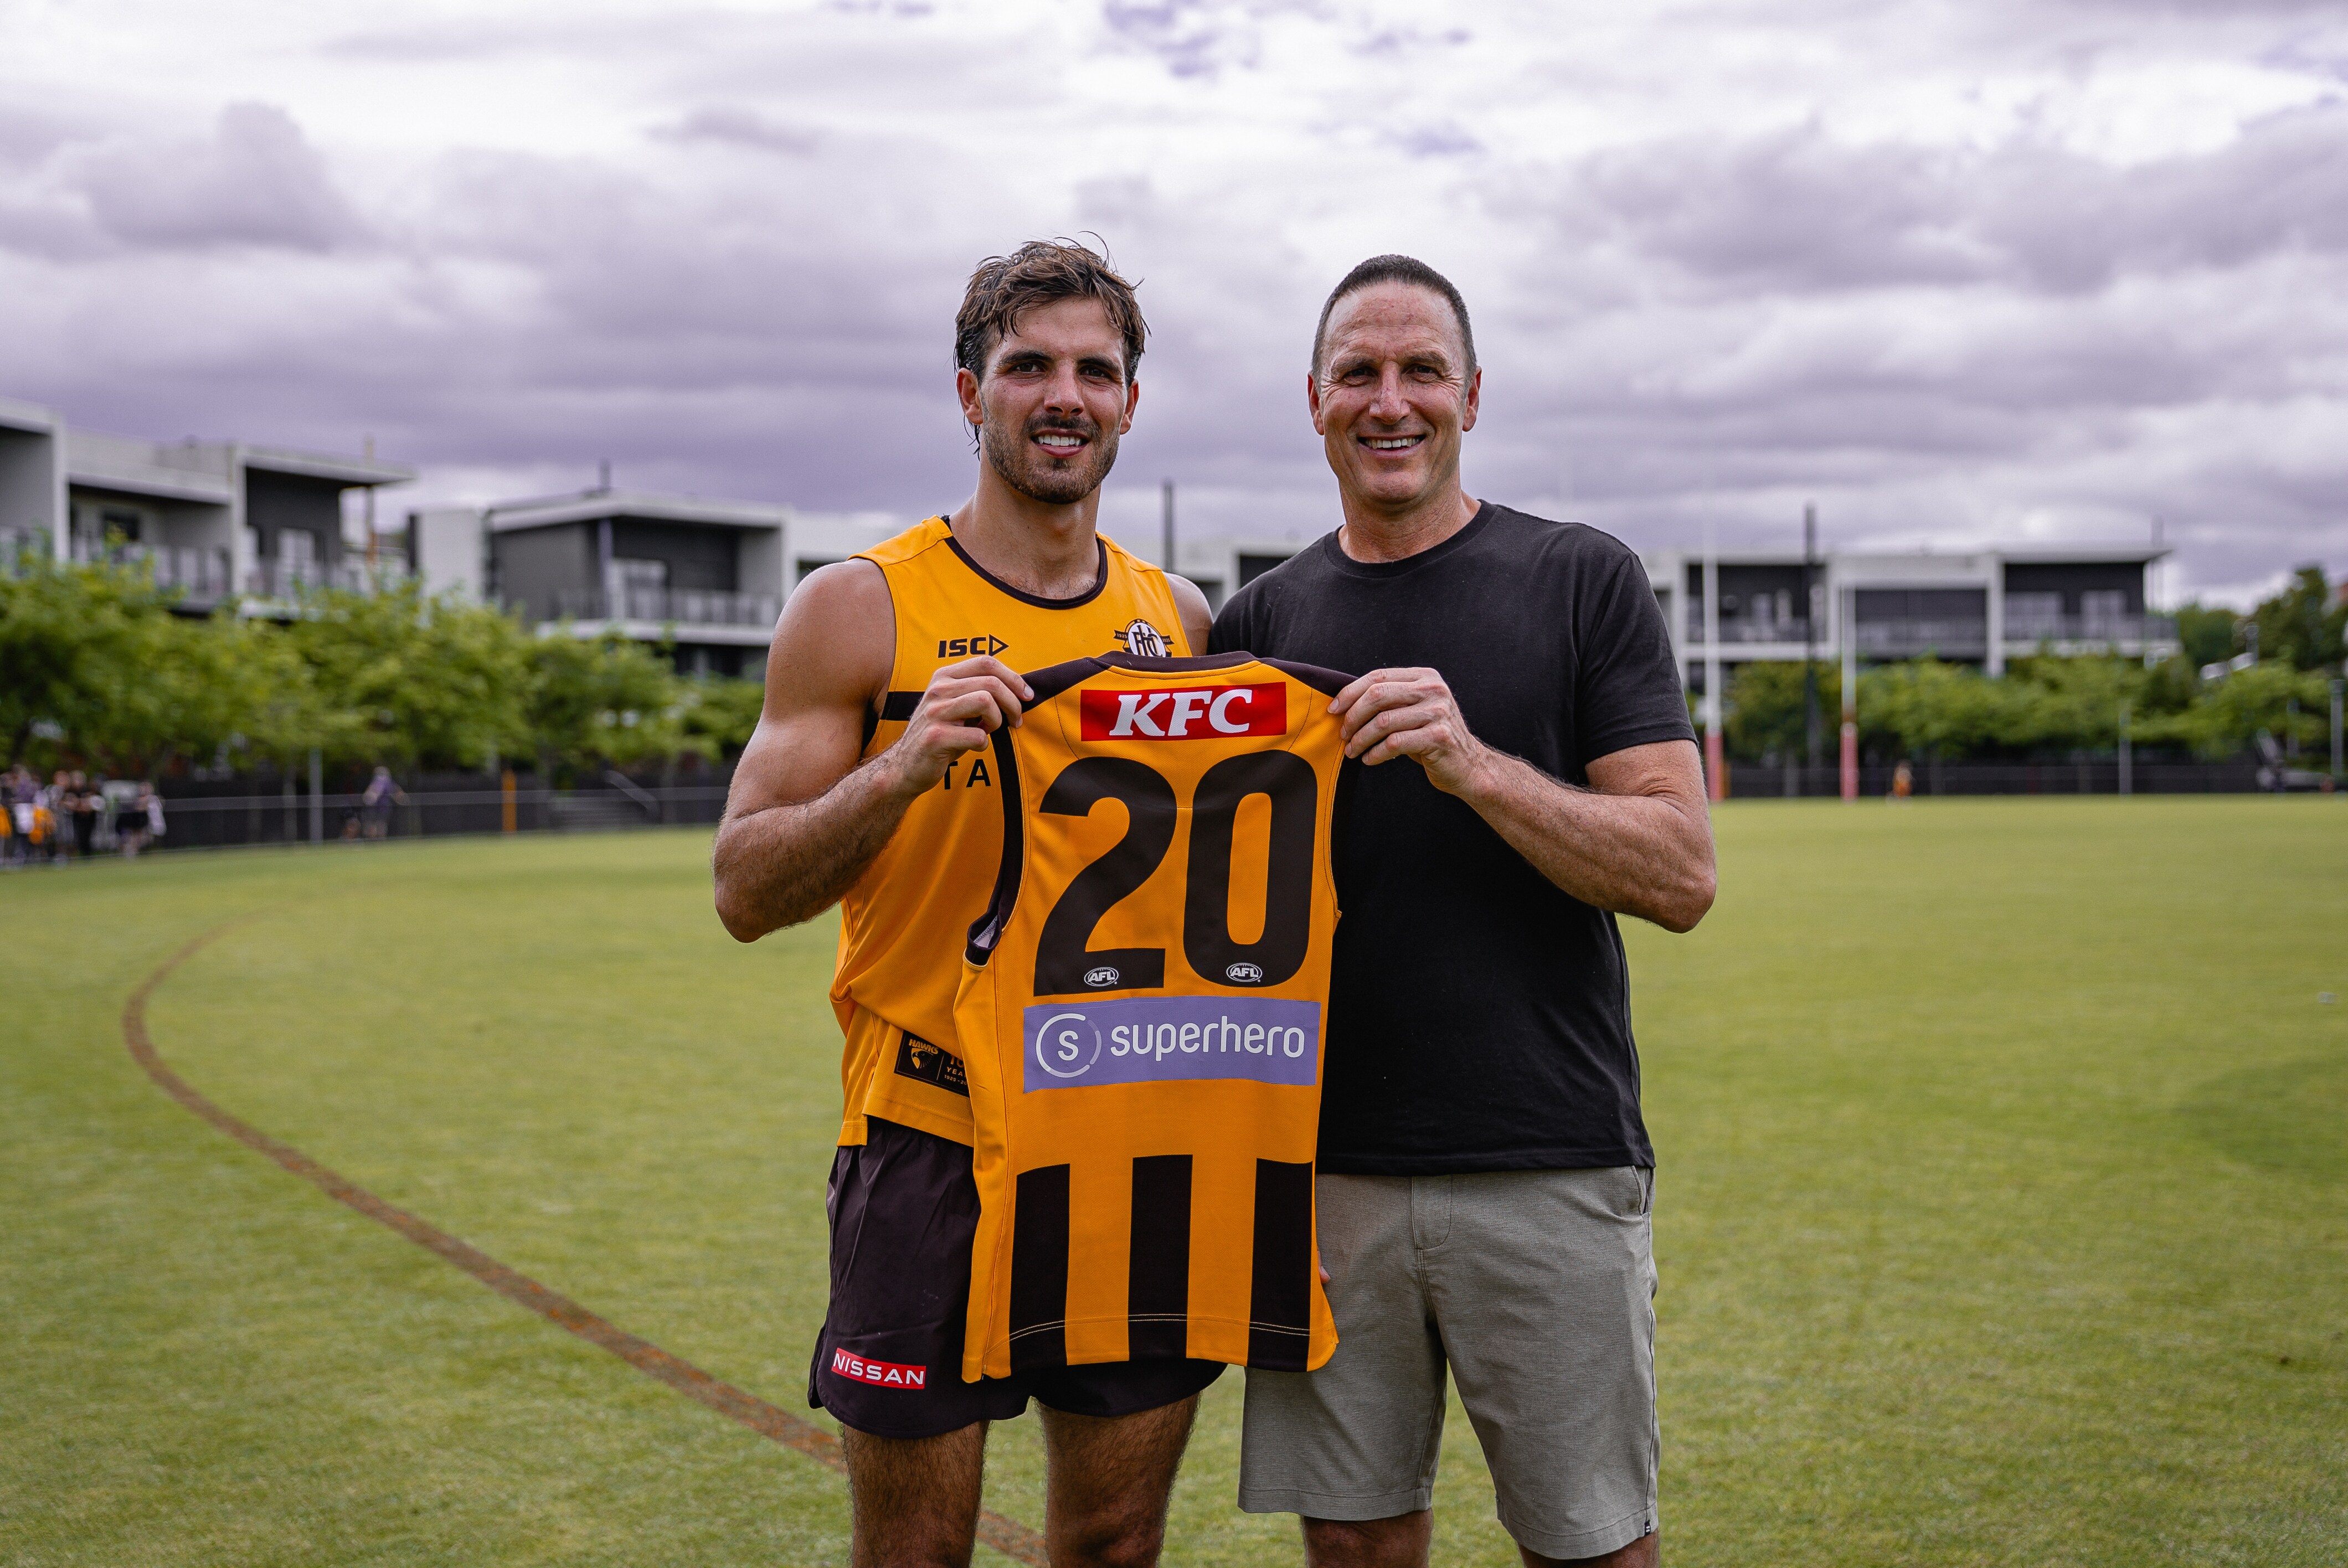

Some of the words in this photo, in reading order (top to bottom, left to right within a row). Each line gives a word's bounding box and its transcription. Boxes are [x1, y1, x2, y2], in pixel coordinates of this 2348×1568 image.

[938, 637, 987, 658] ISC
[1109, 688, 1253, 736] KFC
[1033, 749, 1318, 997] 20
[1088, 971, 1115, 982] AFL
[1230, 967, 1259, 978] AFL
[908, 1039, 939, 1054] HAWKS
[1110, 1015, 1305, 1062] superhero
[946, 1066, 966, 1078] YEA
[833, 1353, 924, 1385] NISSAN
